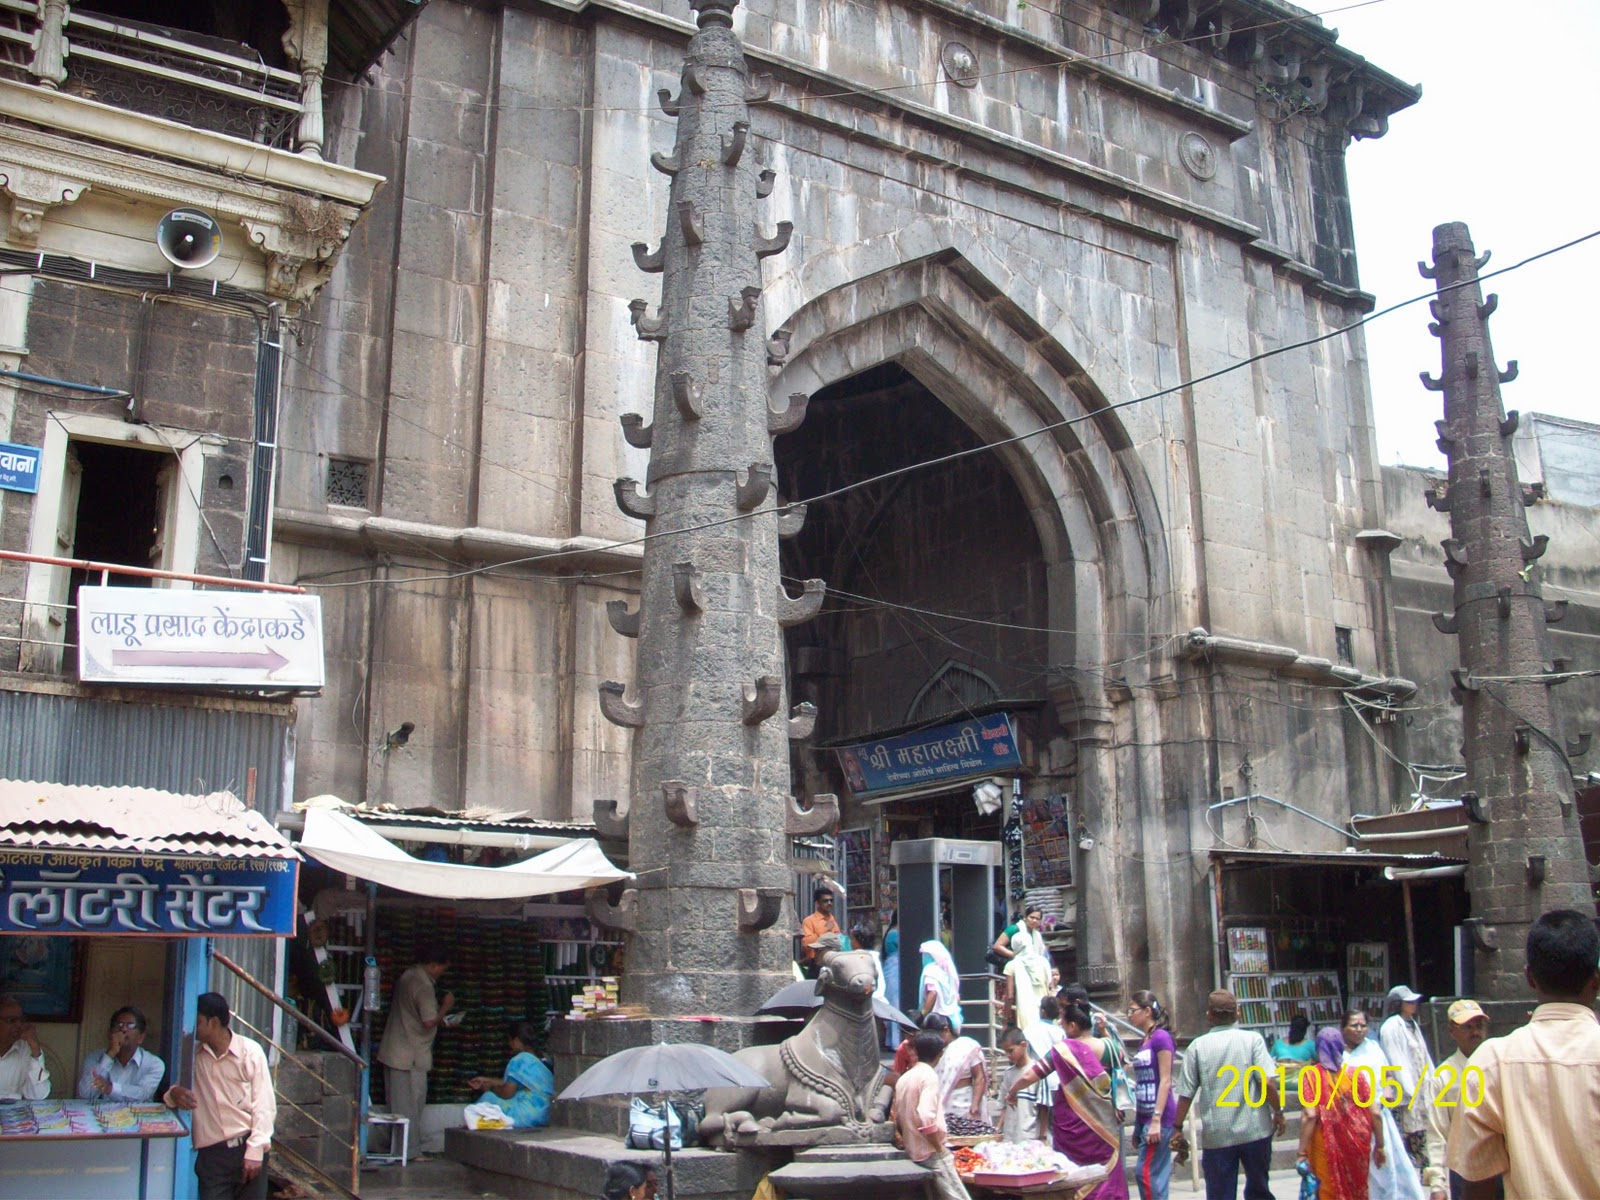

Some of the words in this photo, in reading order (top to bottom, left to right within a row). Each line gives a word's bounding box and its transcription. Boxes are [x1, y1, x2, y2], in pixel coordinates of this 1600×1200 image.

[0, 451, 37, 474] वाना
[90, 611, 142, 646] लाडू
[144, 613, 207, 637] प्रसाद
[212, 606, 306, 641] केंद्राकडे
[870, 745, 891, 769] श्री
[896, 726, 981, 766] महालक्ष्मी
[8, 869, 161, 932] लॉटरी
[165, 873, 272, 932] सेंटर
